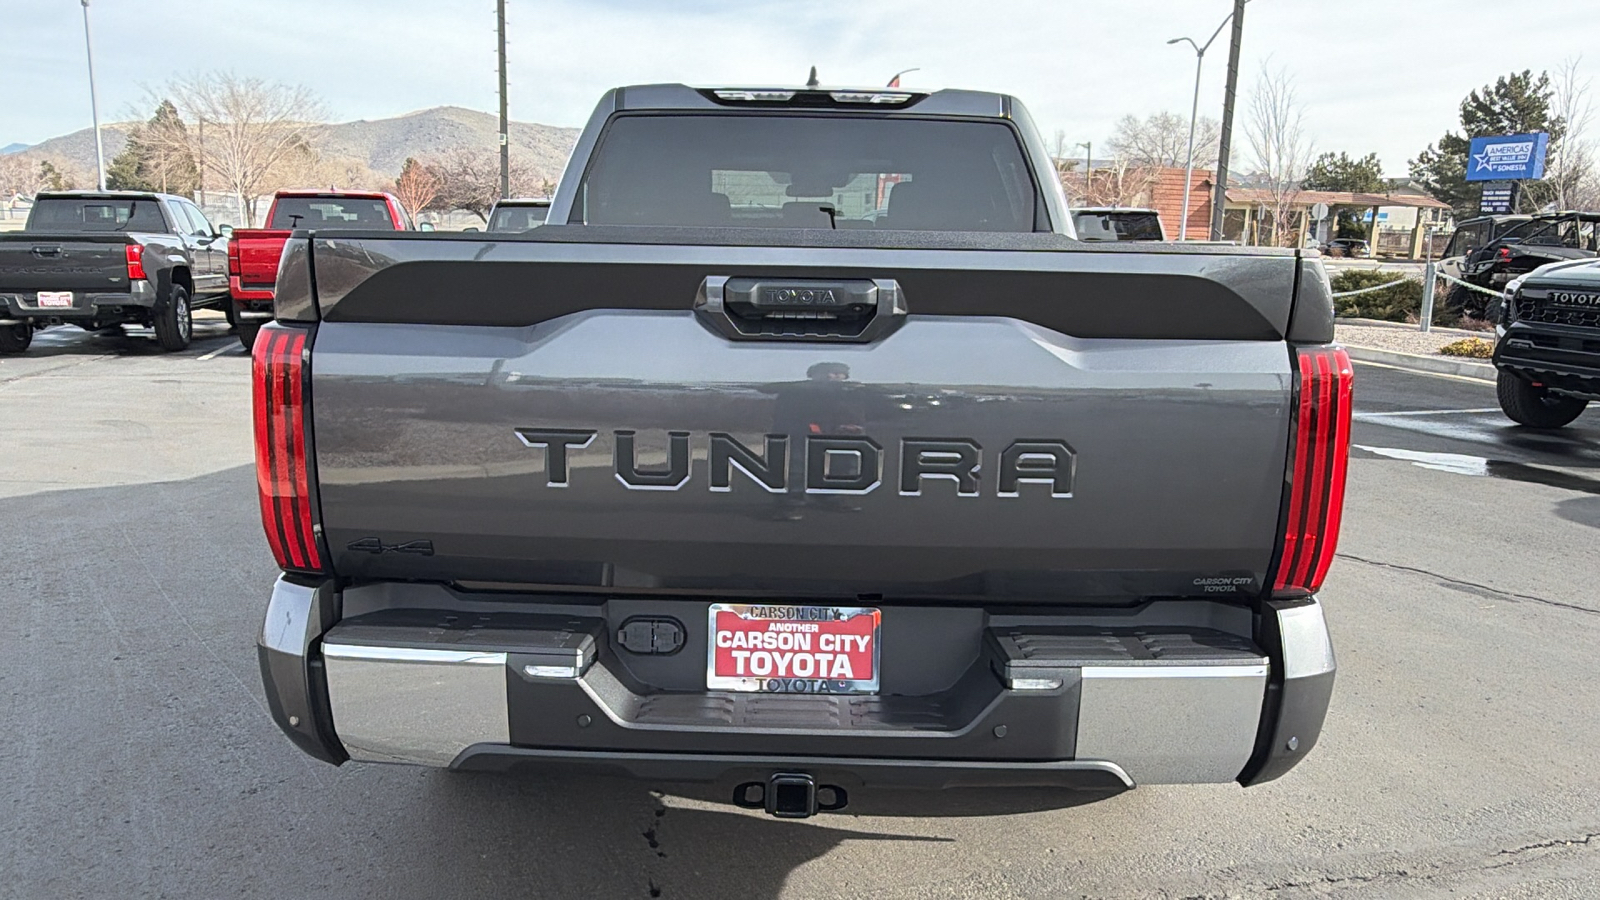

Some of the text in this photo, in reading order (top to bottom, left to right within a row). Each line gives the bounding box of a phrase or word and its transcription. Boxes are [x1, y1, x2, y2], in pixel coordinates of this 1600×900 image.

[1490, 145, 1530, 154] AMERICAS
[766, 289, 836, 304] TOYOTA
[514, 427, 1077, 499] TUNDRA
[750, 606, 840, 621] CARSON CITY
[768, 623, 818, 632] ANOTHER
[717, 630, 871, 653] CARSON CITY
[731, 650, 854, 678] TOYOTA
[754, 678, 831, 693] TOYOTA
